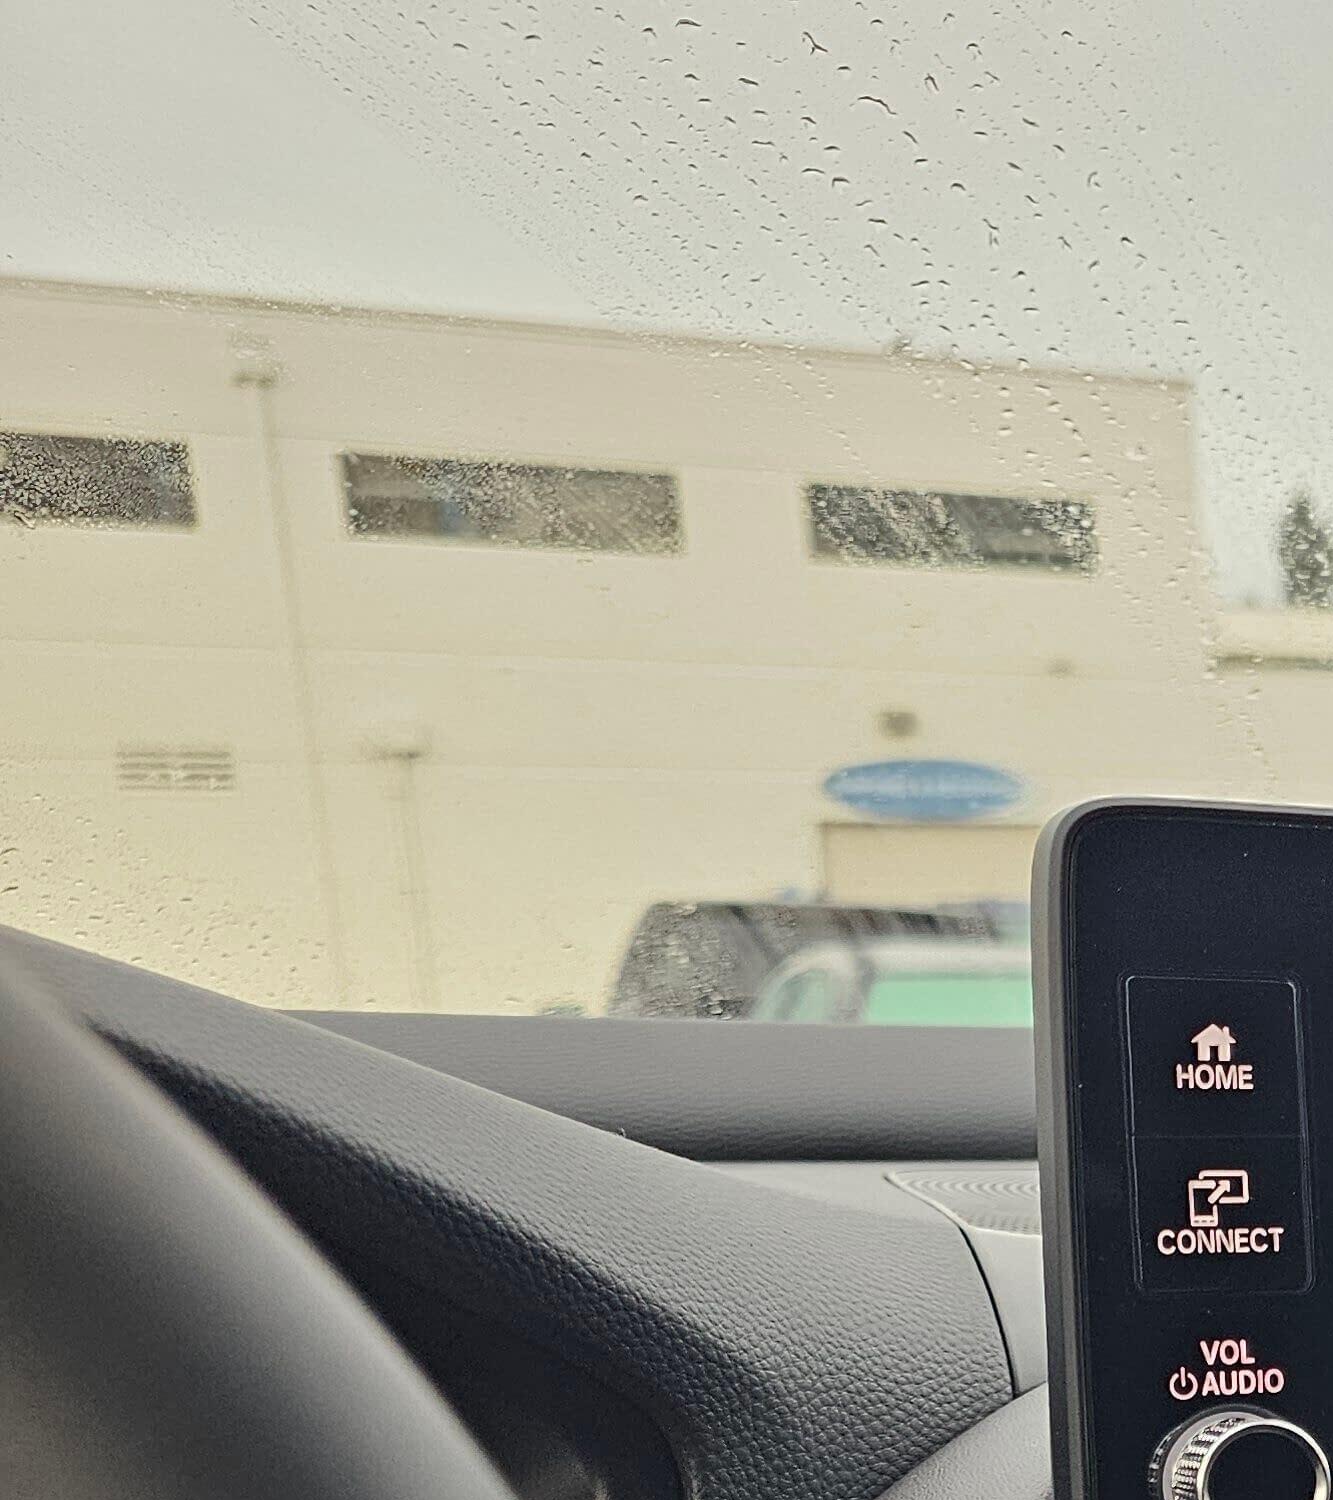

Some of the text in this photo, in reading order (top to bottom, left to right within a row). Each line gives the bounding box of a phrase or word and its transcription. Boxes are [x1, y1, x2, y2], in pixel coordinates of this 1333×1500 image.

[1176, 1064, 1253, 1089] HOME
[1157, 1227, 1285, 1255] CONNECT
[1200, 1339, 1255, 1365] VOL
[1202, 1369, 1284, 1396] AUDIO
